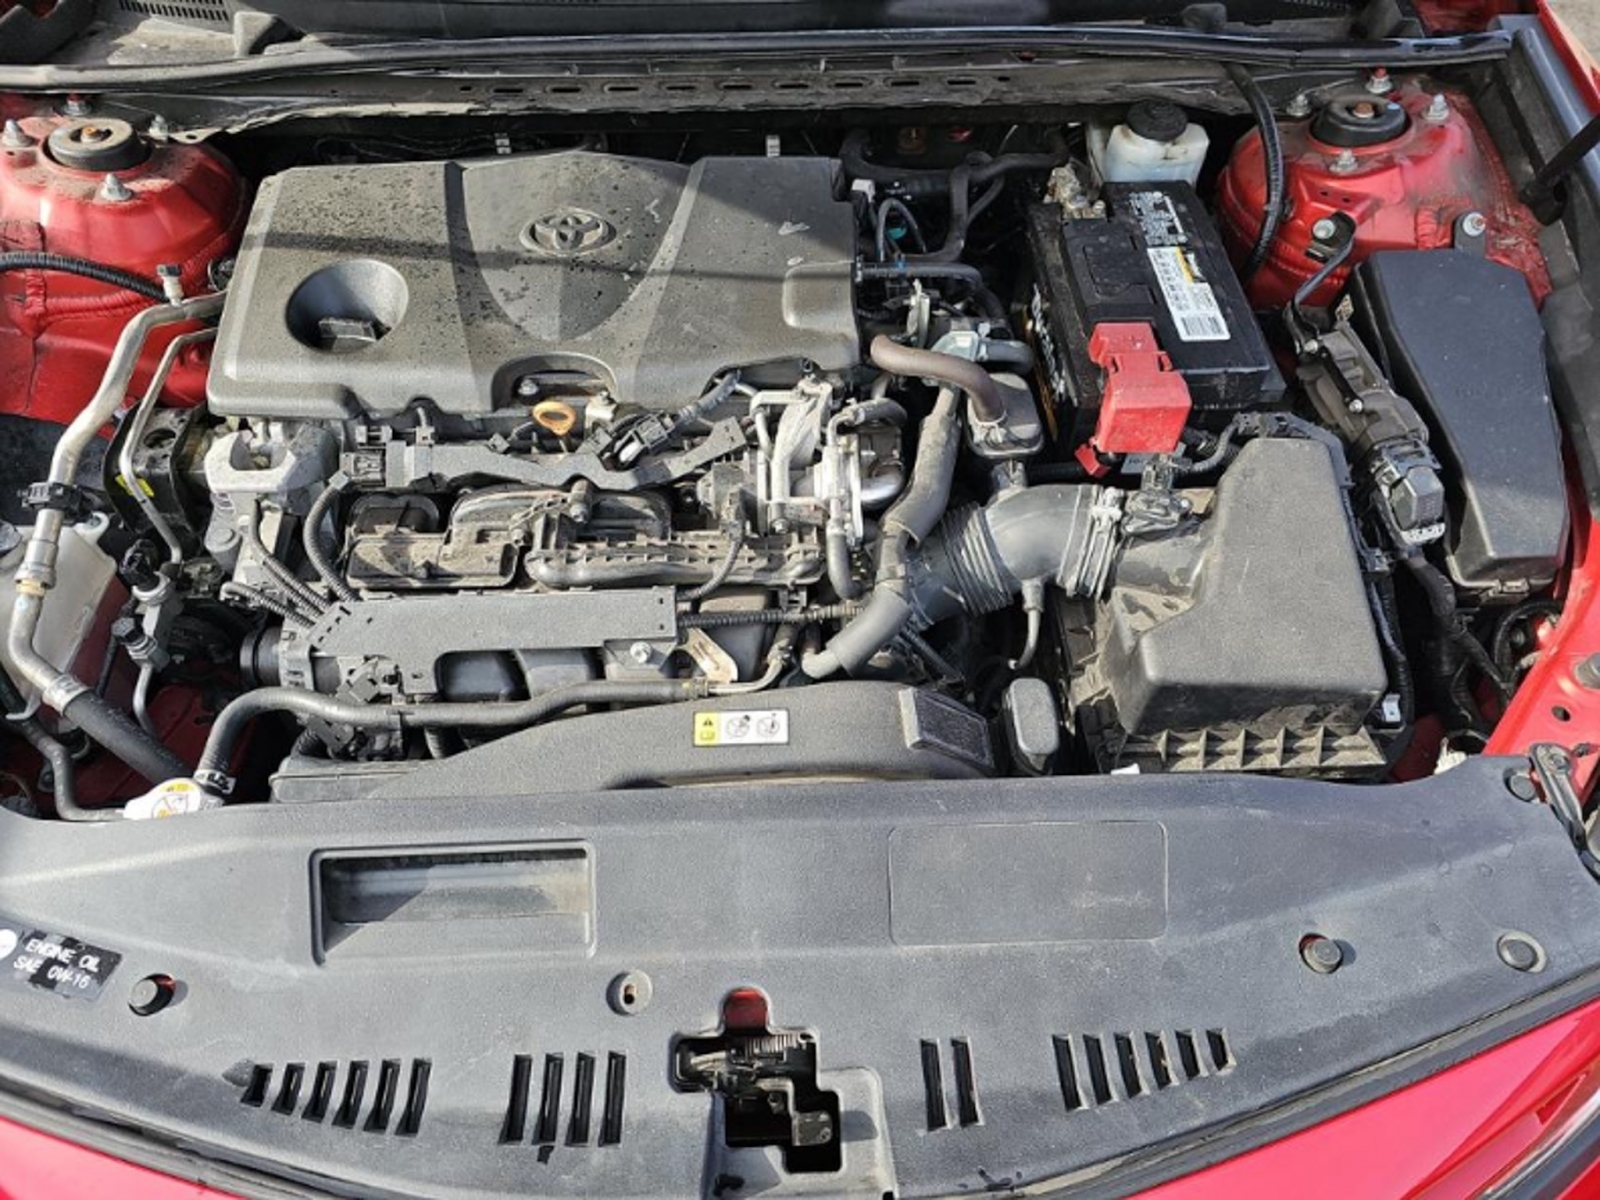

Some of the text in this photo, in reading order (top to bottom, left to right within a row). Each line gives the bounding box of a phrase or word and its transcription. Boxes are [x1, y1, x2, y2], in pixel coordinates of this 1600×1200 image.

[13, 955, 91, 989] SAE 0W-16
[25, 939, 100, 973] ENGINE OIL
